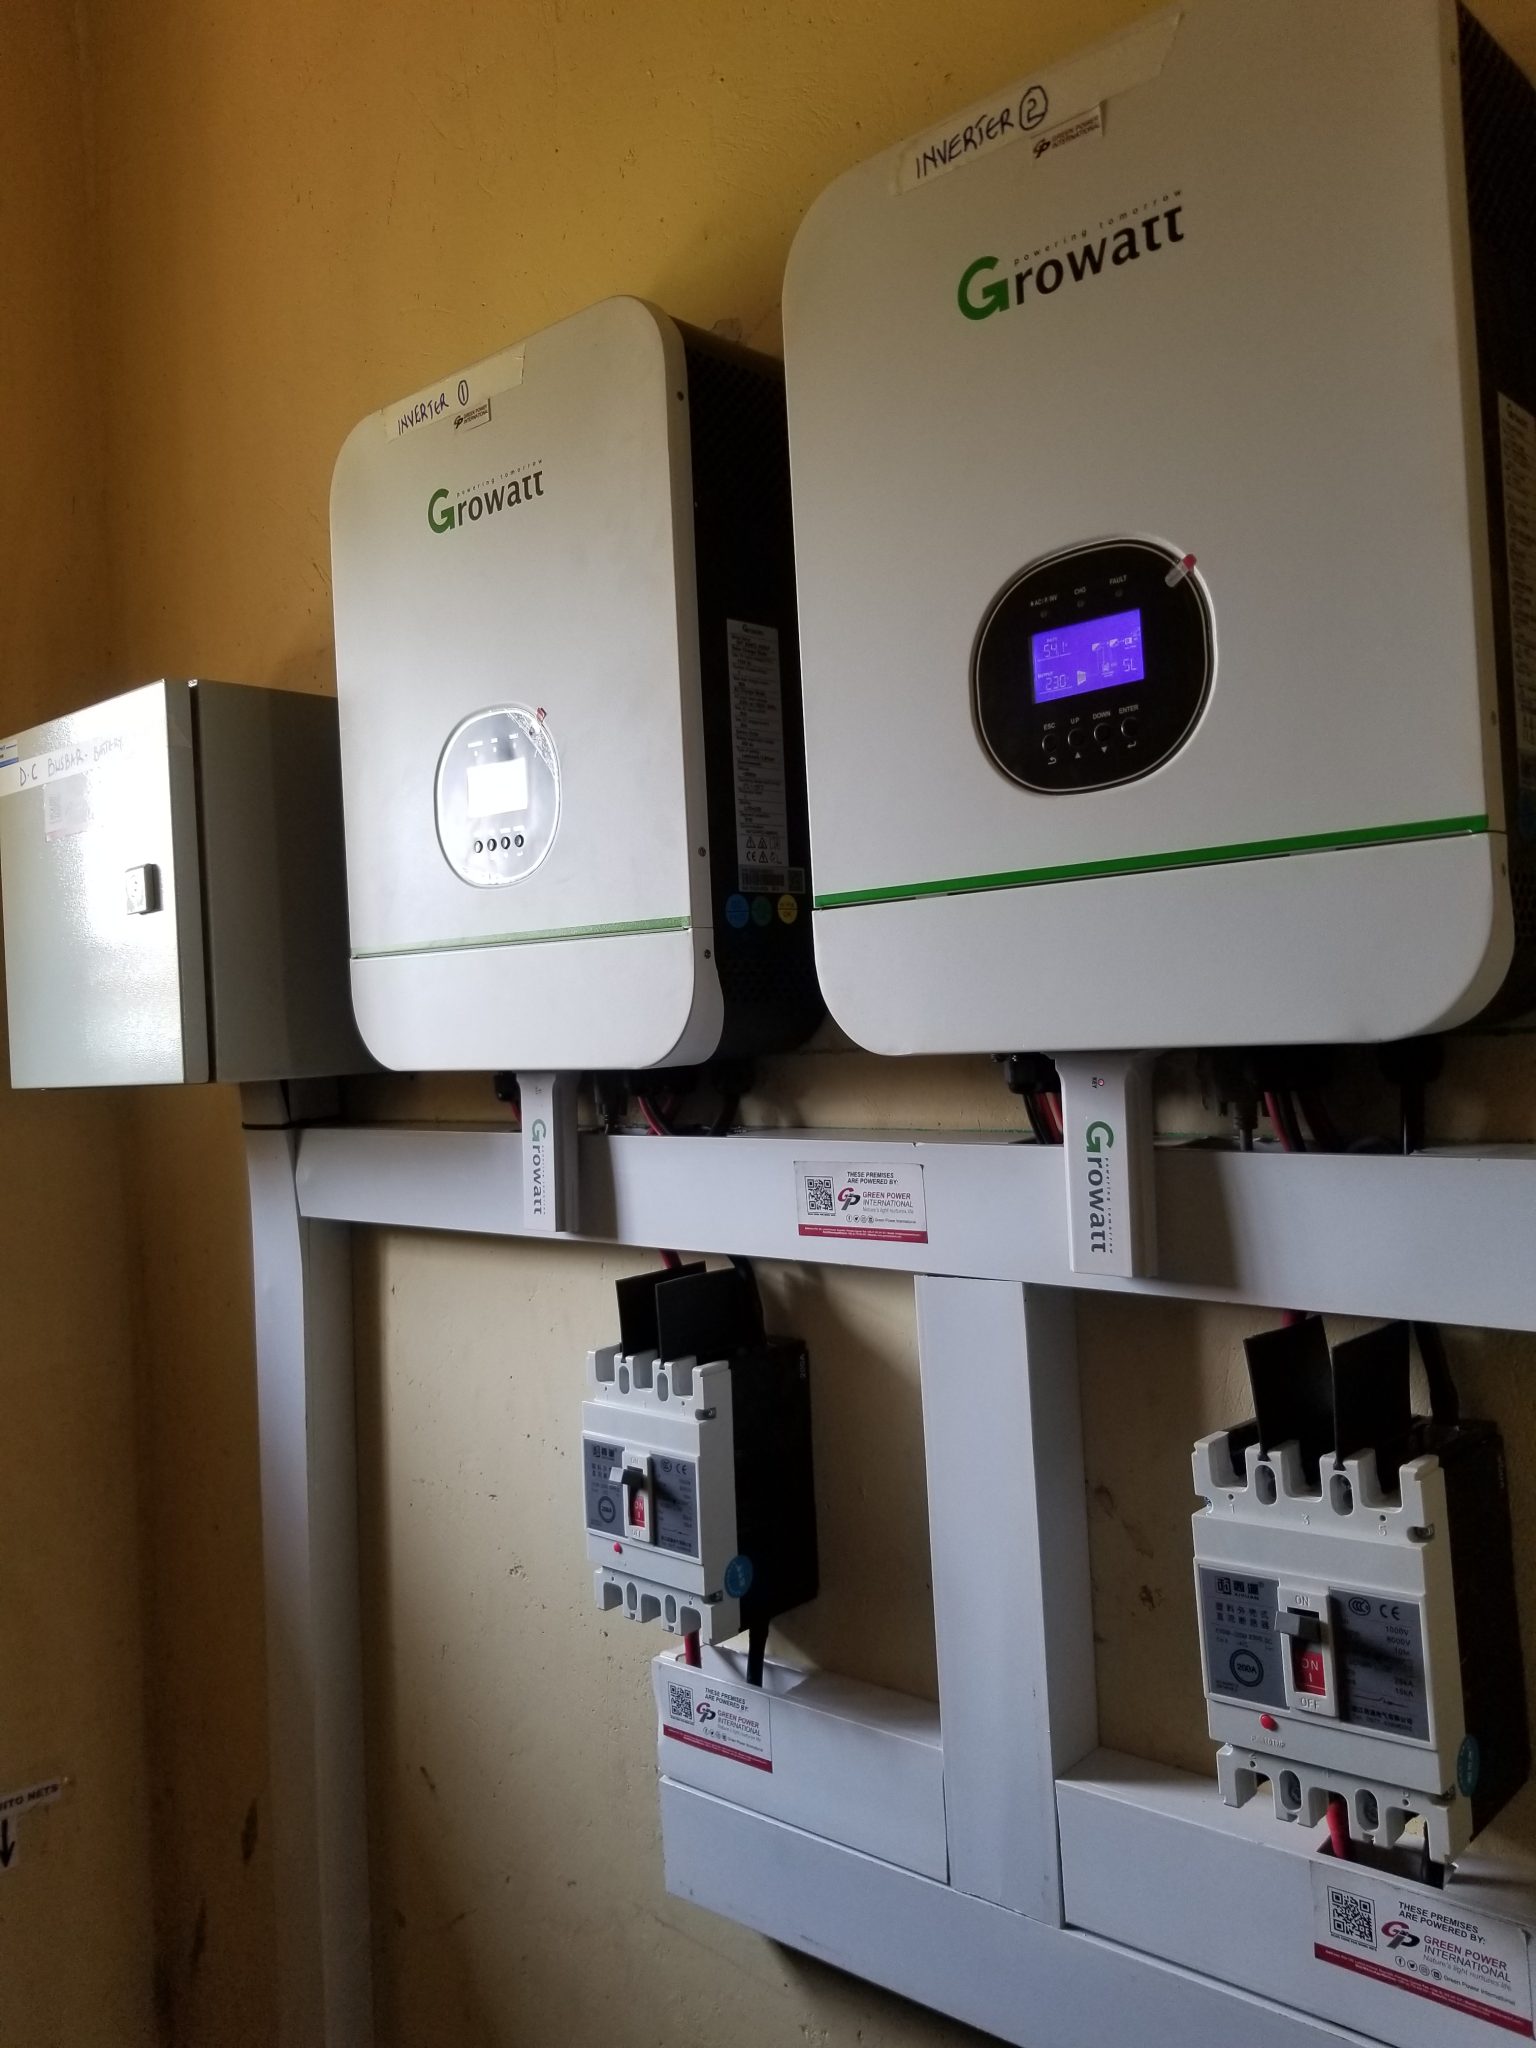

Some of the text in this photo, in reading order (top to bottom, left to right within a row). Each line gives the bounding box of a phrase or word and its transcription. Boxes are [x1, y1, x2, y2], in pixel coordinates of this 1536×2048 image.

[916, 108, 1014, 179] INVERTER
[1014, 189, 1182, 267] powering tomorrow
[957, 206, 1184, 320] Growatt
[398, 393, 449, 435] INVERTER
[427, 470, 544, 534] Growatt
[1109, 574, 1127, 585] FAULT
[1045, 674, 1067, 691] 230
[1092, 711, 1111, 720] DOWN
[1118, 704, 1139, 715] ENTER
[1043, 722, 1056, 731] ESC
[1070, 717, 1080, 725] UP
[532, 1118, 547, 1215] Growatt
[1086, 1120, 1114, 1253] Growatt
[862, 1191, 911, 1200] GREEN POWER
[863, 1199, 913, 1208] INTERNATIONAL
[676, 1463, 688, 1475] CE
[634, 1500, 644, 1510] ON
[1302, 1513, 1310, 1526] 3
[1377, 1525, 1387, 1537] 5
[1295, 1594, 1310, 1608] ON
[1379, 1603, 1400, 1620] CE
[1385, 1625, 1409, 1636] 1000V
[1236, 1662, 1258, 1675] 200A
[1302, 1658, 1319, 1671] ON
[705, 1687, 745, 1704] THESE PREMISES
[716, 1698, 740, 1709] POWERED
[1301, 1697, 1320, 1710] OFF
[718, 1709, 760, 1729] GREEN POWER
[718, 1717, 761, 1736] INTERNATIONAL
[1398, 1901, 1479, 1934] THESE PREMISES
[1398, 1909, 1486, 1945] ARE POWERED BY:
[1423, 1935, 1507, 1971] GREEN POWER
[1424, 1945, 1511, 1982] INTERNATIONAL
[1453, 1964, 1468, 1976] light
[1443, 1975, 1461, 1986] Green
[1461, 1981, 1480, 1993] Power
